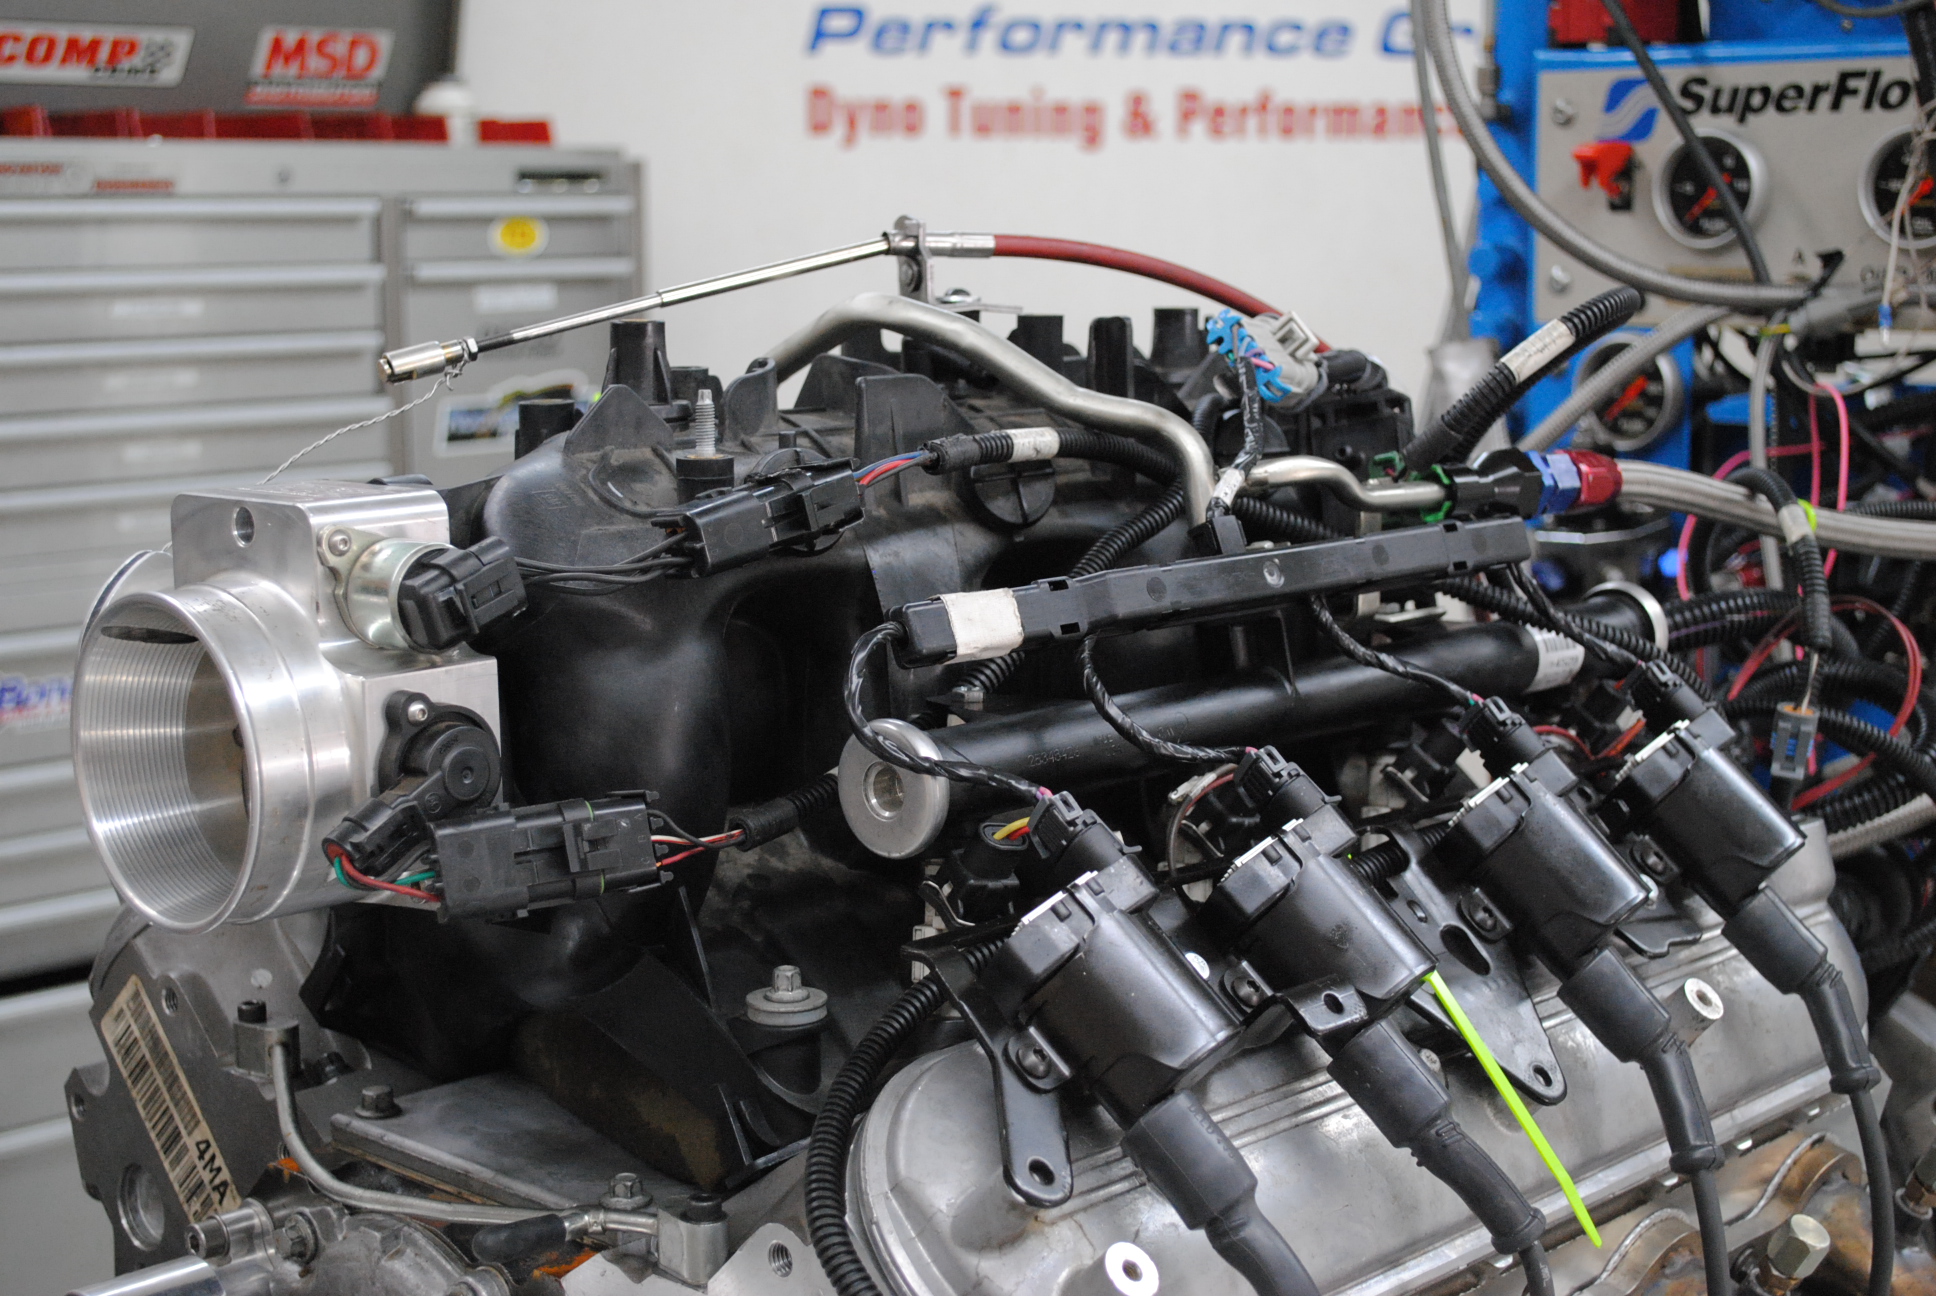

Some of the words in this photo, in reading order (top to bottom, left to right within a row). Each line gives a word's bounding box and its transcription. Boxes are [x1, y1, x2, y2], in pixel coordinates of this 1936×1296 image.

[0, 33, 138, 68] COMP
[261, 30, 380, 81] MSD
[806, 4, 1354, 57] Performance
[806, 85, 924, 148] Dyno
[944, 86, 1104, 151] Tuning
[1123, 91, 1155, 138] &
[1679, 69, 1914, 124] SuperFlo
[195, 1138, 230, 1206] 4MA
